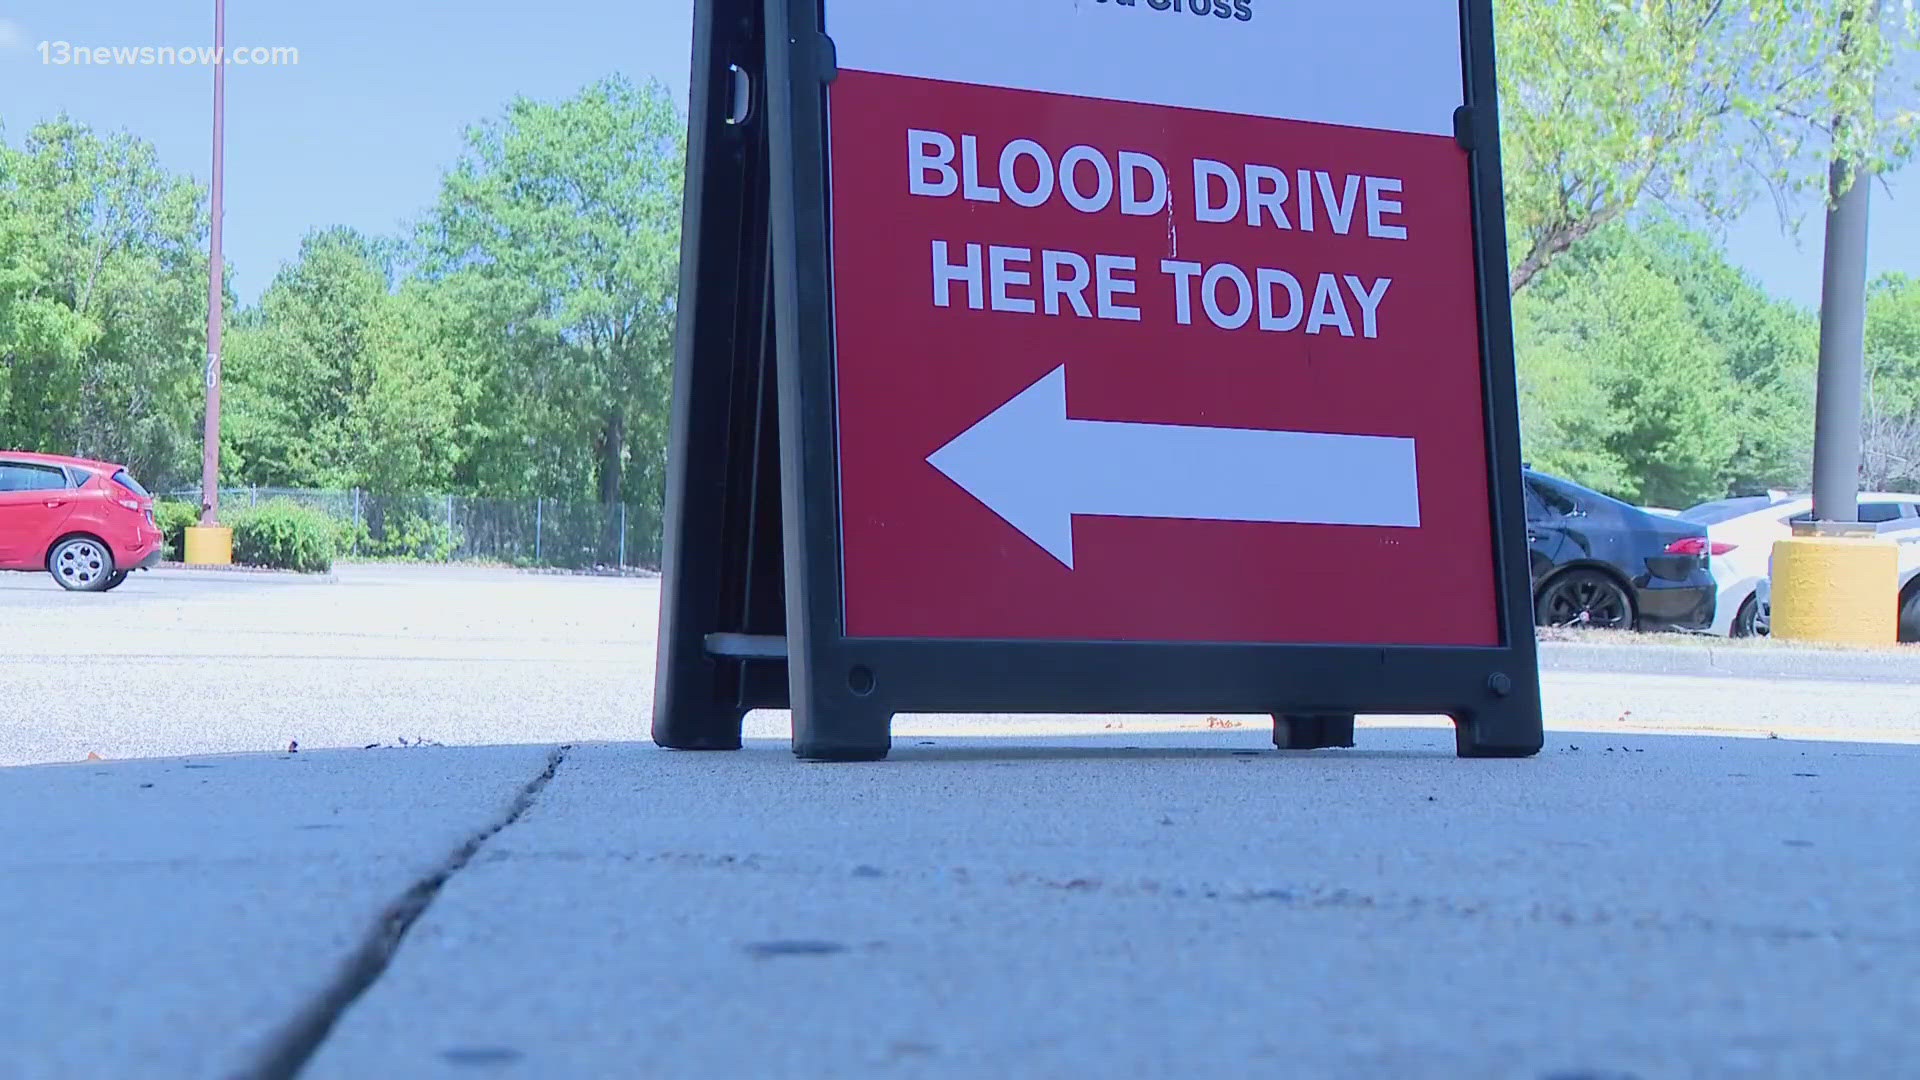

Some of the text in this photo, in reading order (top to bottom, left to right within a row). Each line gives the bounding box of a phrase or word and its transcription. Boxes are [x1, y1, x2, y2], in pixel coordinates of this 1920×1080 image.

[907, 128, 1409, 241] BLOOD DRIVE
[932, 240, 1392, 339] HERE TODAY
